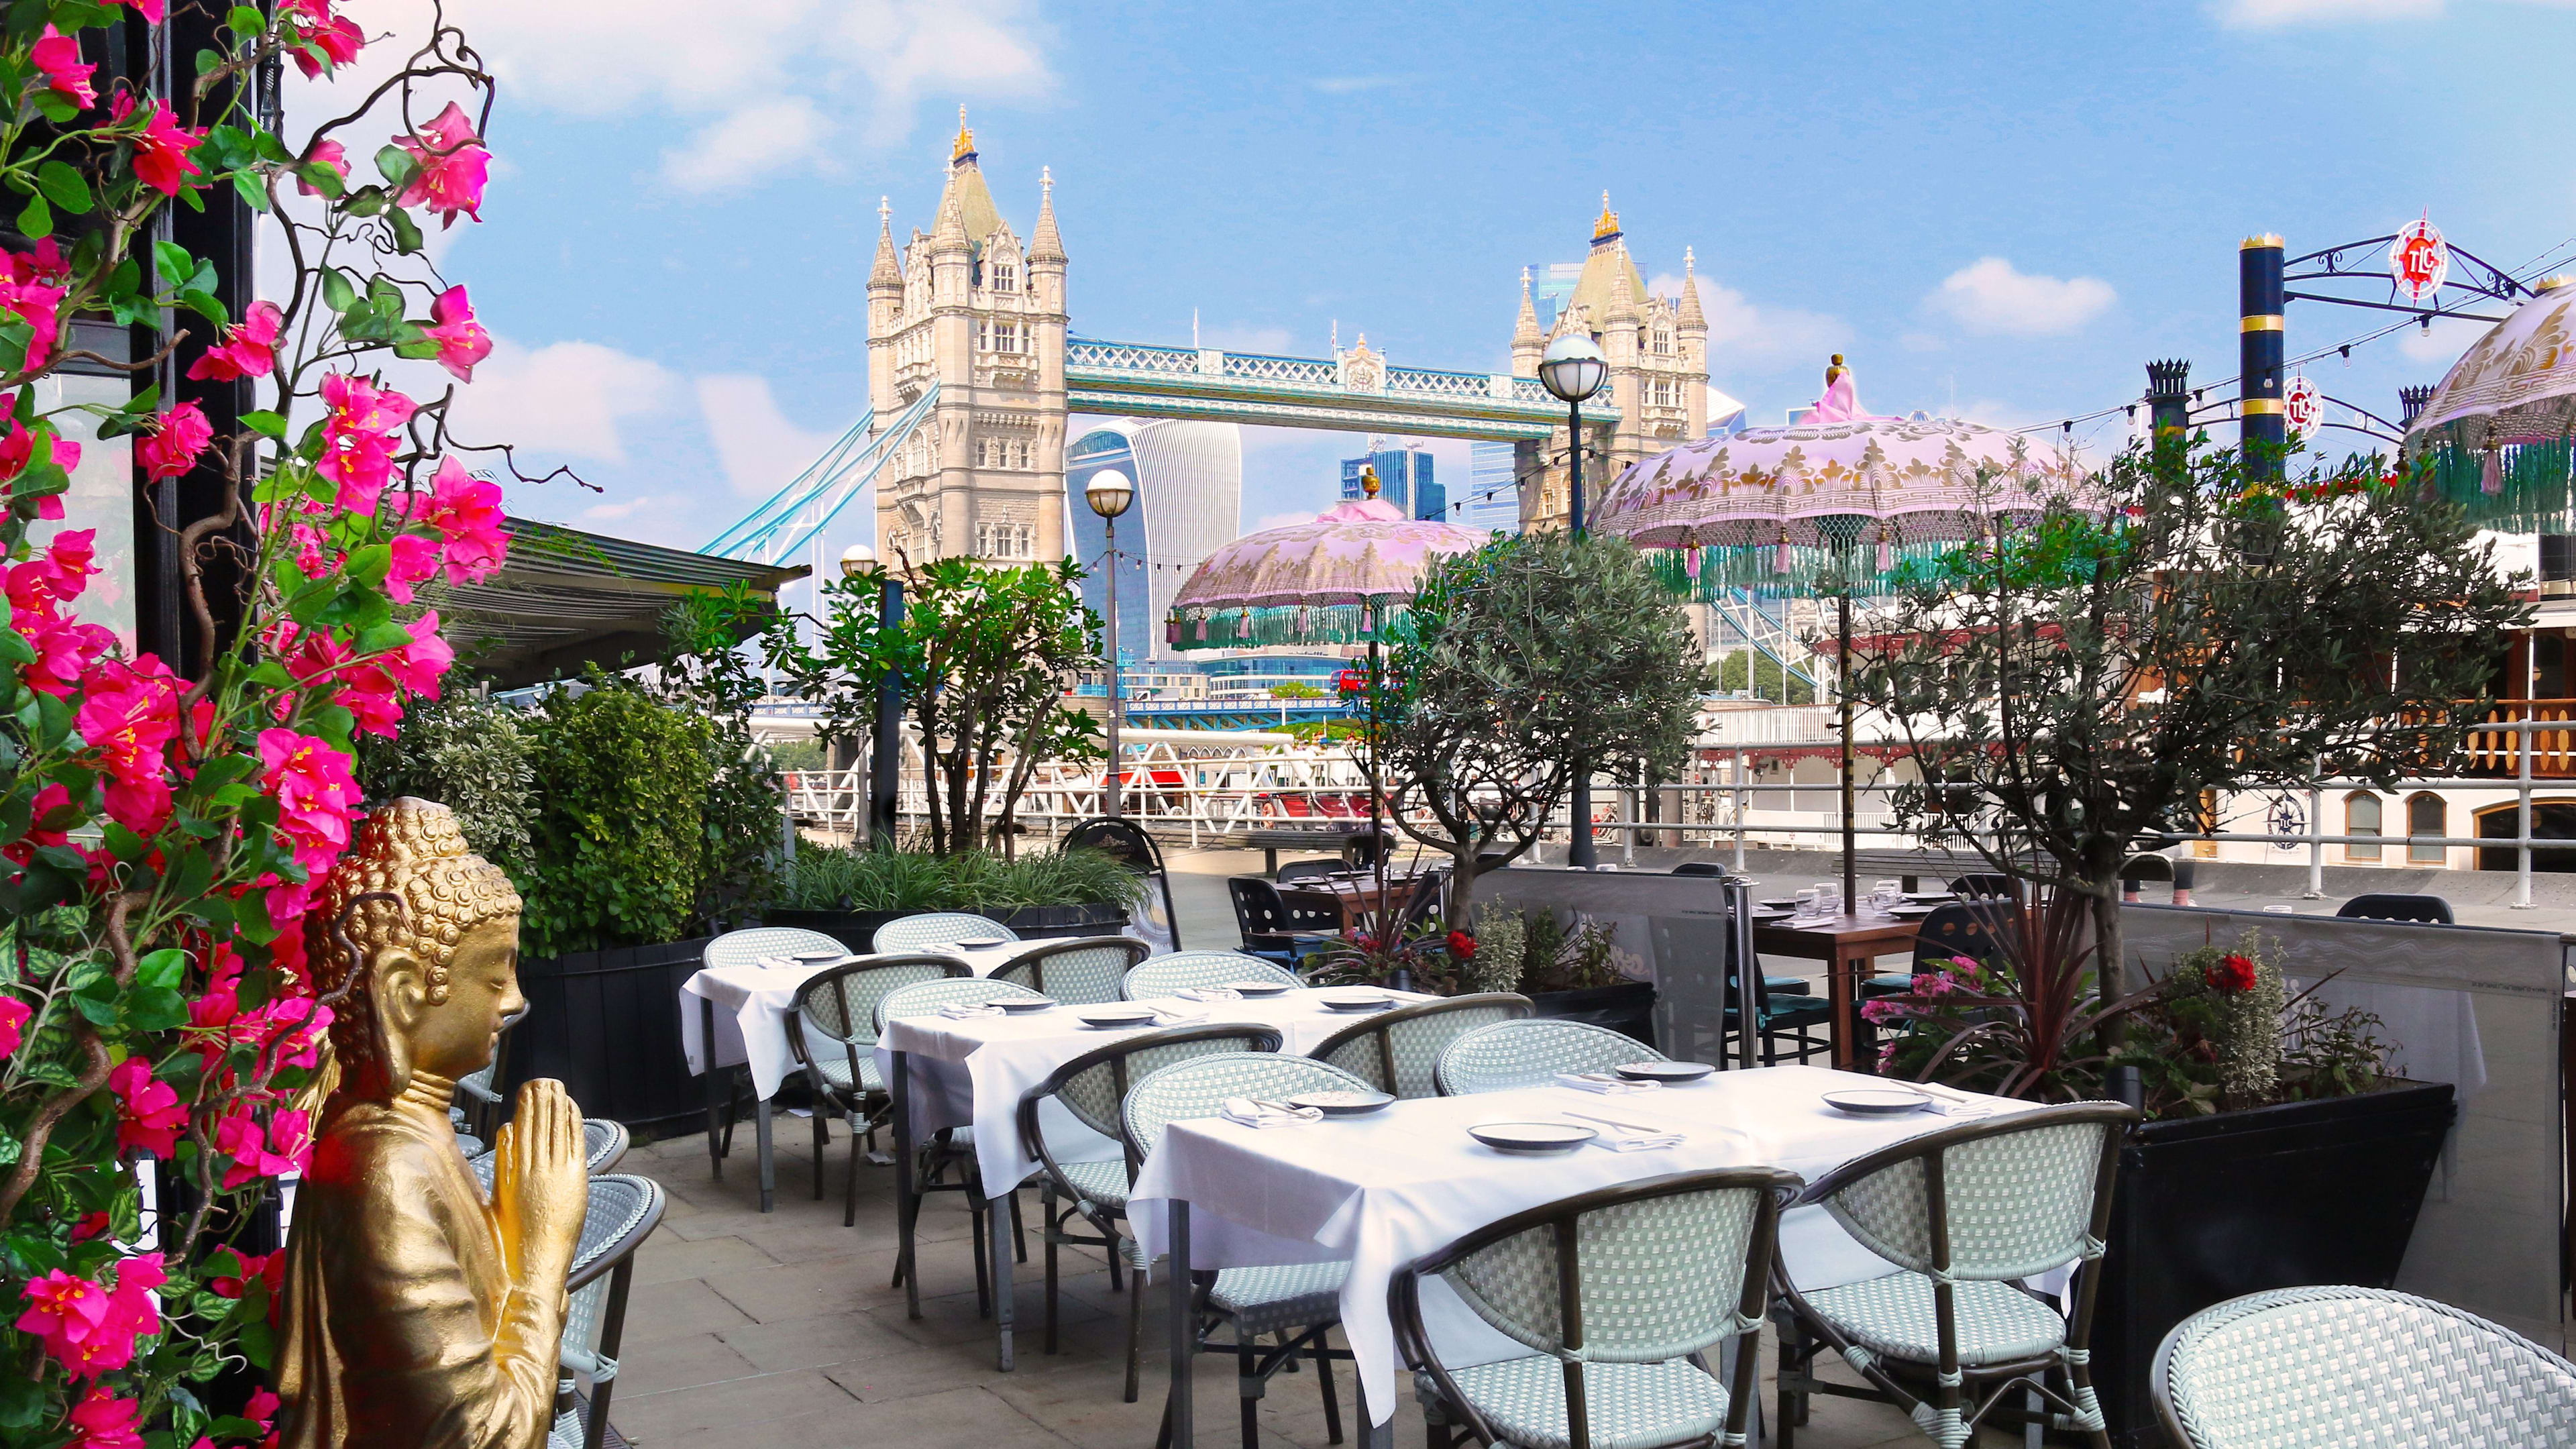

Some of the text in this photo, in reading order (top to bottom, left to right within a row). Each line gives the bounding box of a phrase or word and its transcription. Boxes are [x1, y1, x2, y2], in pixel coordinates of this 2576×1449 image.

[2409, 246, 2434, 274] TLC
[2291, 398, 2310, 419] TLC
[2279, 818, 2292, 828] TLC
